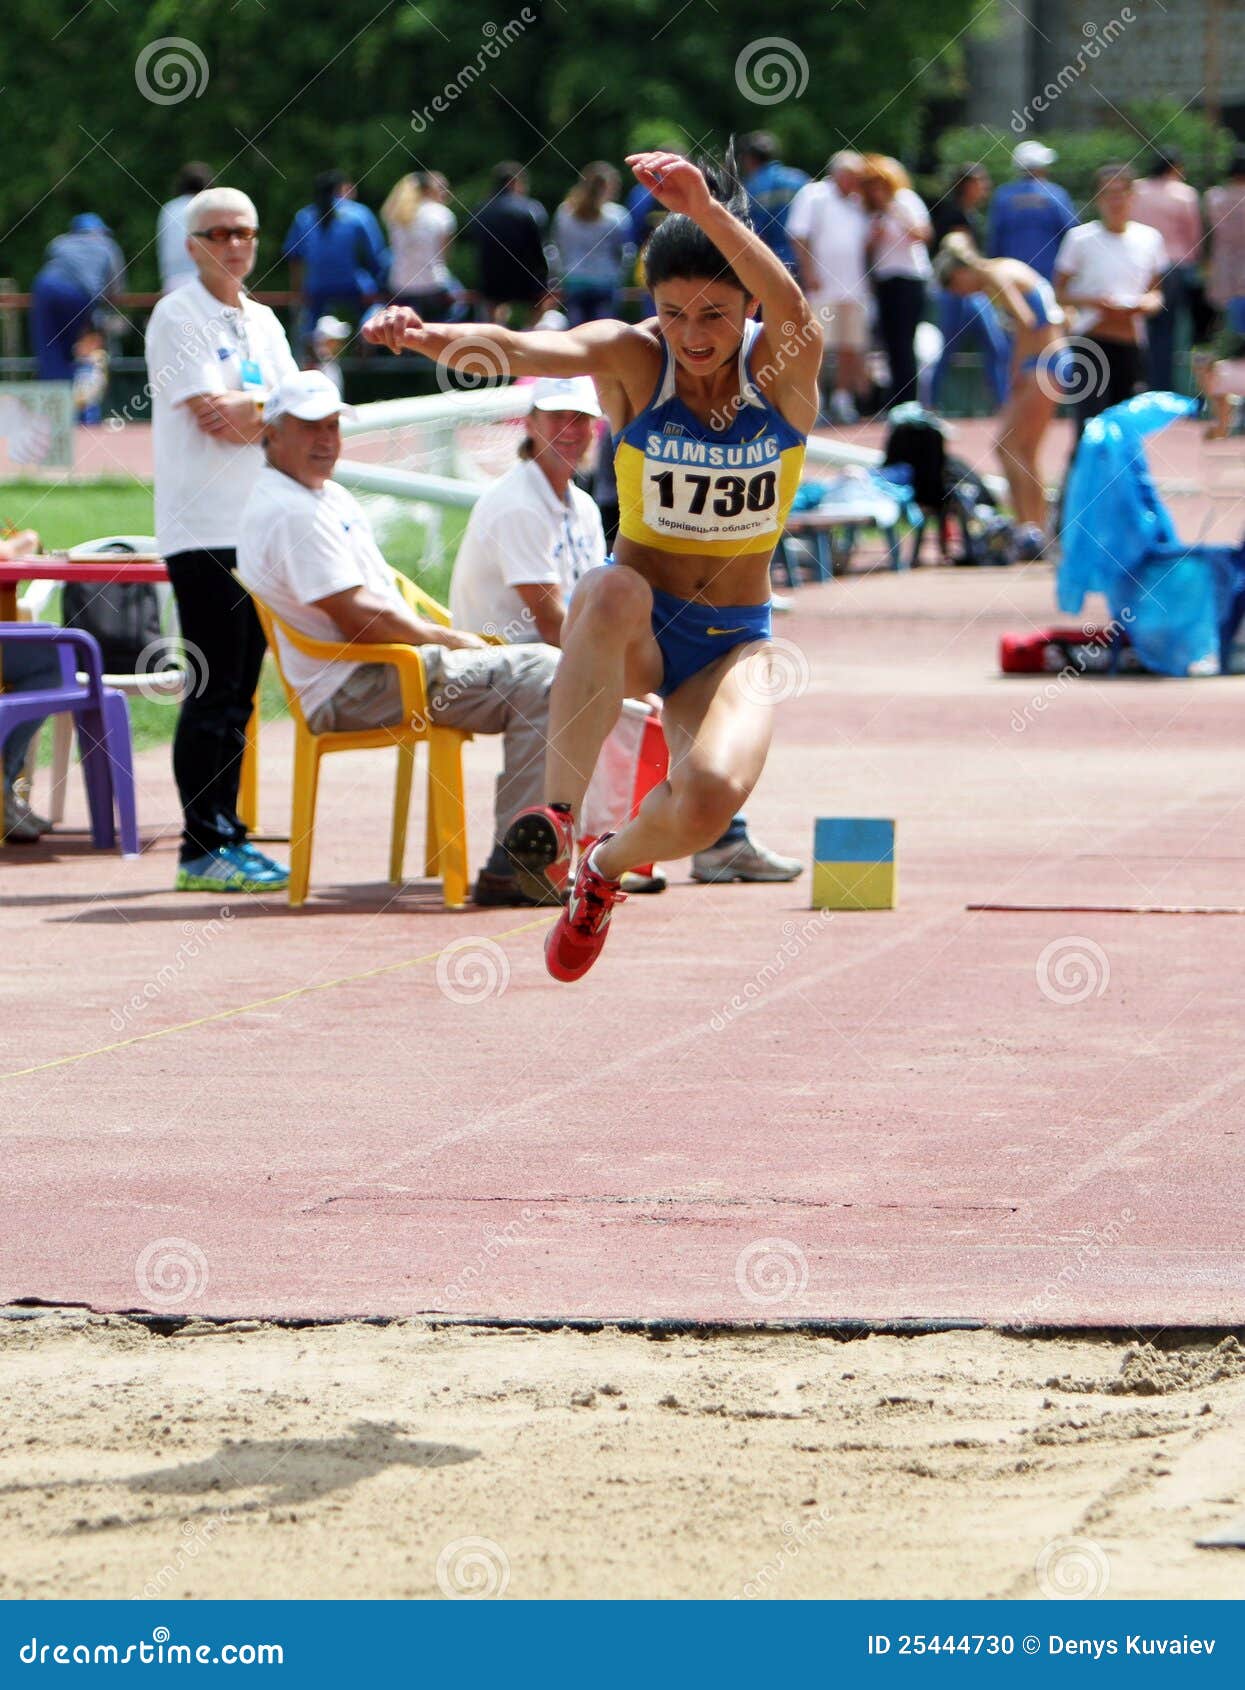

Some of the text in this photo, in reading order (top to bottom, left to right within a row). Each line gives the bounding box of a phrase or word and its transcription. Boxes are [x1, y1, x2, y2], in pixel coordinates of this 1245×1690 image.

[647, 435, 779, 466] SAMSUNG
[650, 470, 776, 518] 1730
[721, 521, 762, 533] область
